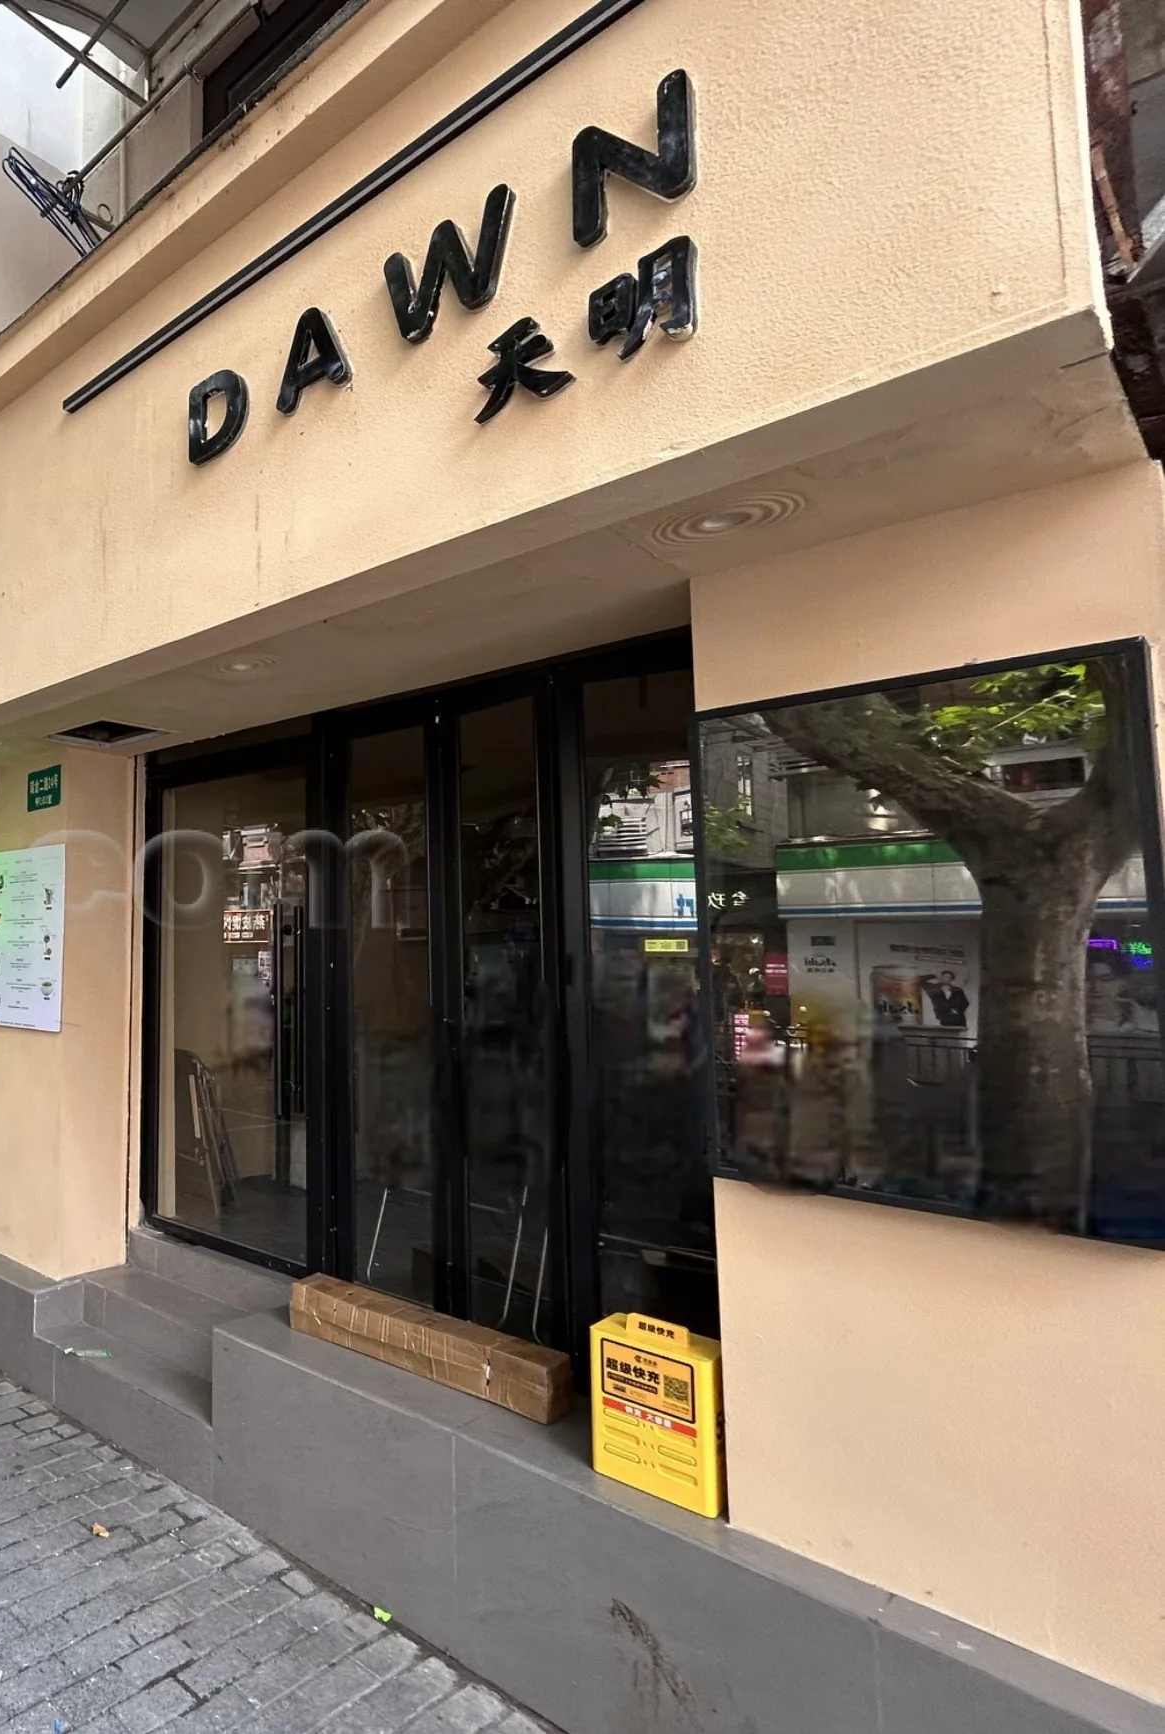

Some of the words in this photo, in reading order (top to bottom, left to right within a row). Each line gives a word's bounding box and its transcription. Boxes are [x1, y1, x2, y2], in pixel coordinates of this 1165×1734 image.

[186, 69, 697, 467] DAWN
[472, 235, 700, 425] 天明
[606, 1357, 661, 1386] 超级快充
[638, 1321, 675, 1340] 超级快充
